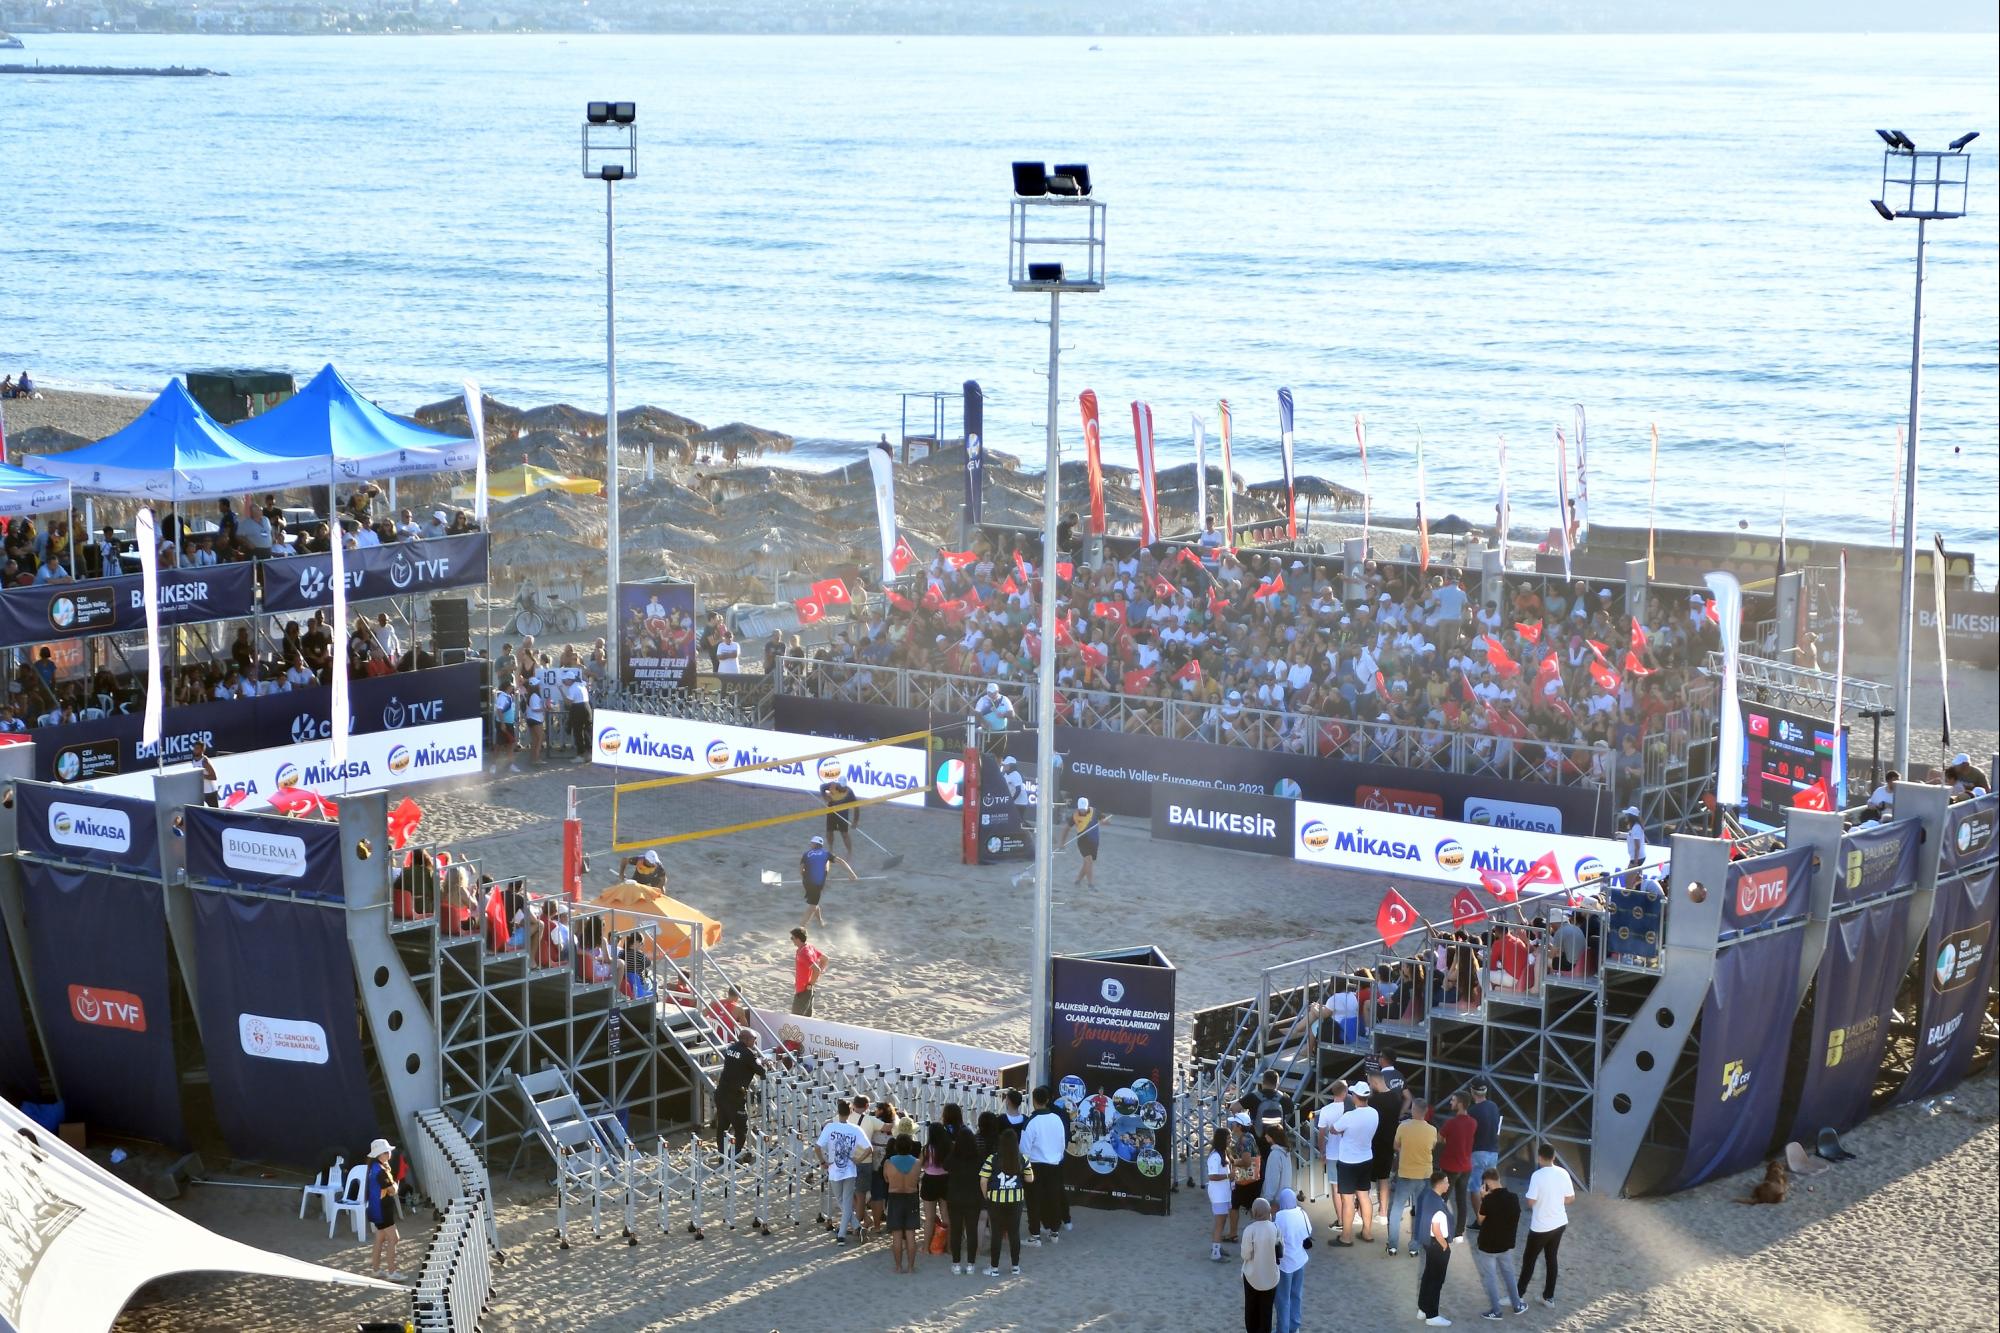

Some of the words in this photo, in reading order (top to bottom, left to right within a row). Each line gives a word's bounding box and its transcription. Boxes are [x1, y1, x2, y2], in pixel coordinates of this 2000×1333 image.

[415, 558, 449, 581] TVF
[543, 671, 556, 686] 10
[408, 700, 443, 724] TVF
[413, 741, 478, 768] MIKASA
[625, 732, 695, 762] MIKASA
[303, 758, 371, 786] MIKASA
[847, 760, 919, 790] MIKASA
[1072, 762, 1093, 775] CEV
[1095, 765, 1126, 780] Beach
[1162, 773, 1212, 788] European
[1239, 783, 1264, 796] 2023
[995, 795, 1009, 805] TVF
[1394, 802, 1437, 818] TVF
[74, 816, 126, 841] MIKASA
[1169, 804, 1276, 838] BALIKESİR
[1494, 811, 1556, 833] MIKASA
[229, 840, 297, 860] BIODERMA
[1334, 826, 1422, 862] MIKASA
[1759, 880, 1784, 904] TVF
[102, 1000, 139, 1024] TVF
[1055, 1002, 1089, 1014] BALIKESİR
[1090, 1004, 1132, 1018] BÜYÜKŞEHİR
[1132, 1008, 1170, 1021] BELEDİYESİ
[1065, 1014, 1095, 1025] OLARAK
[1096, 1016, 1161, 1031] SPORCULARIMIZIN
[809, 1033, 823, 1045] T.C.
[824, 1036, 859, 1051] Balıkesir
[950, 1062, 960, 1070] T.C.
[961, 1064, 988, 1075] GENÇLİK
[989, 1069, 998, 1077] VE
[997, 1171, 1018, 1189] 12
